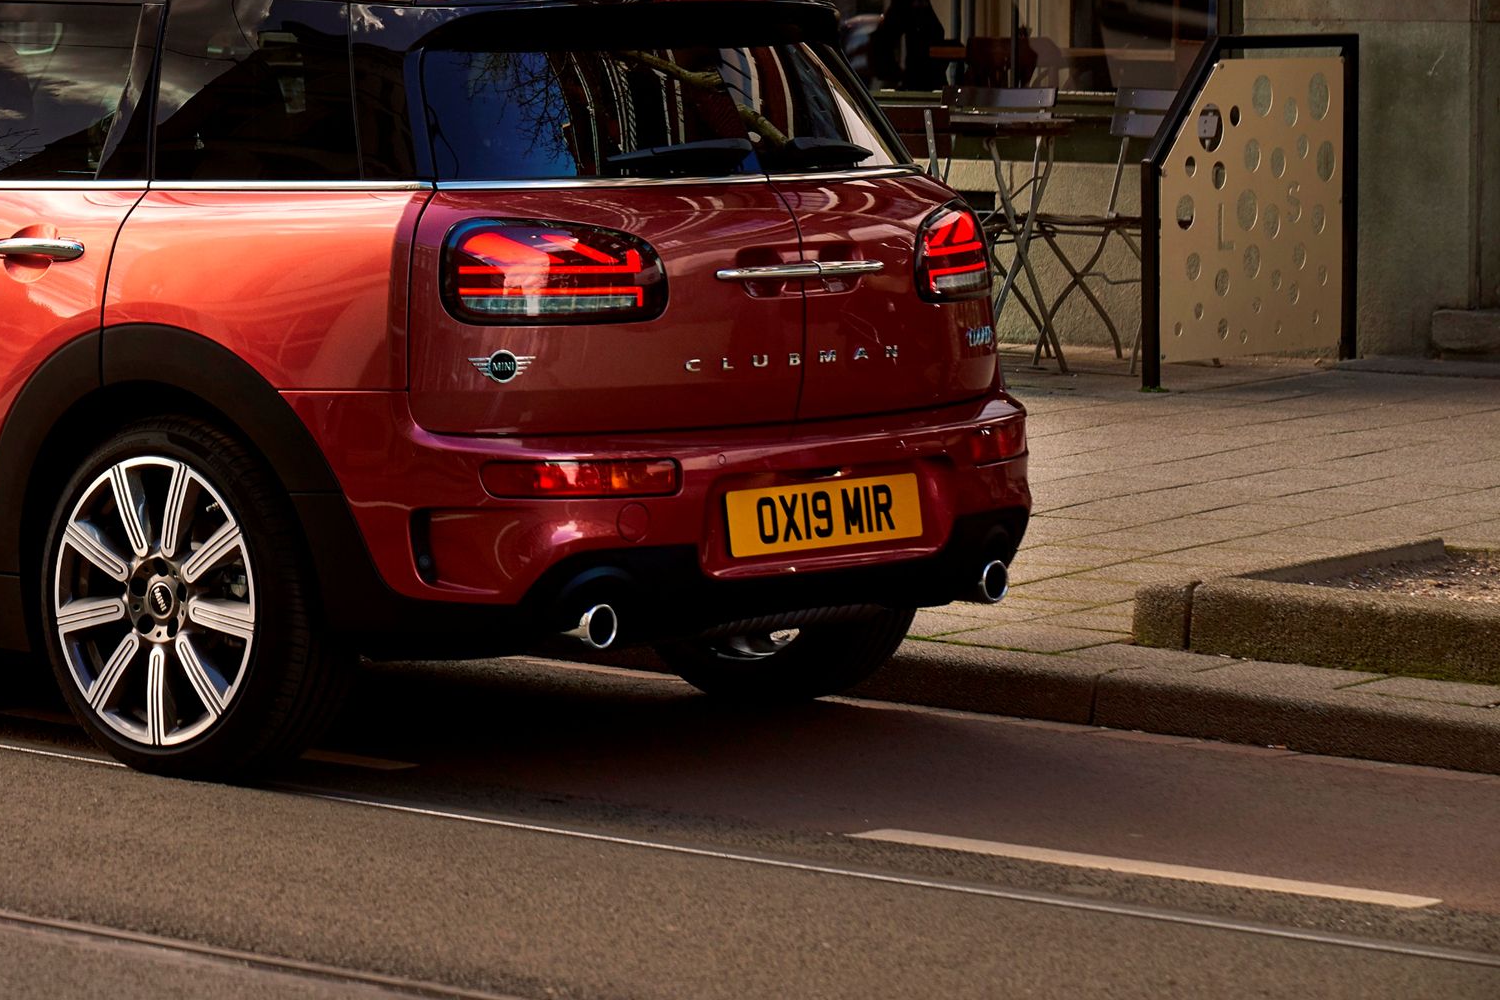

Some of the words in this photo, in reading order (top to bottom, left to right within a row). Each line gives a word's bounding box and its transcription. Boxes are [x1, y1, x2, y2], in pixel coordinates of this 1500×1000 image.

[492, 361, 515, 372] MINI
[685, 344, 898, 372] CLUBMAN
[757, 490, 834, 544] OX19
[841, 484, 895, 535] MIR
[153, 587, 167, 612] MINI
